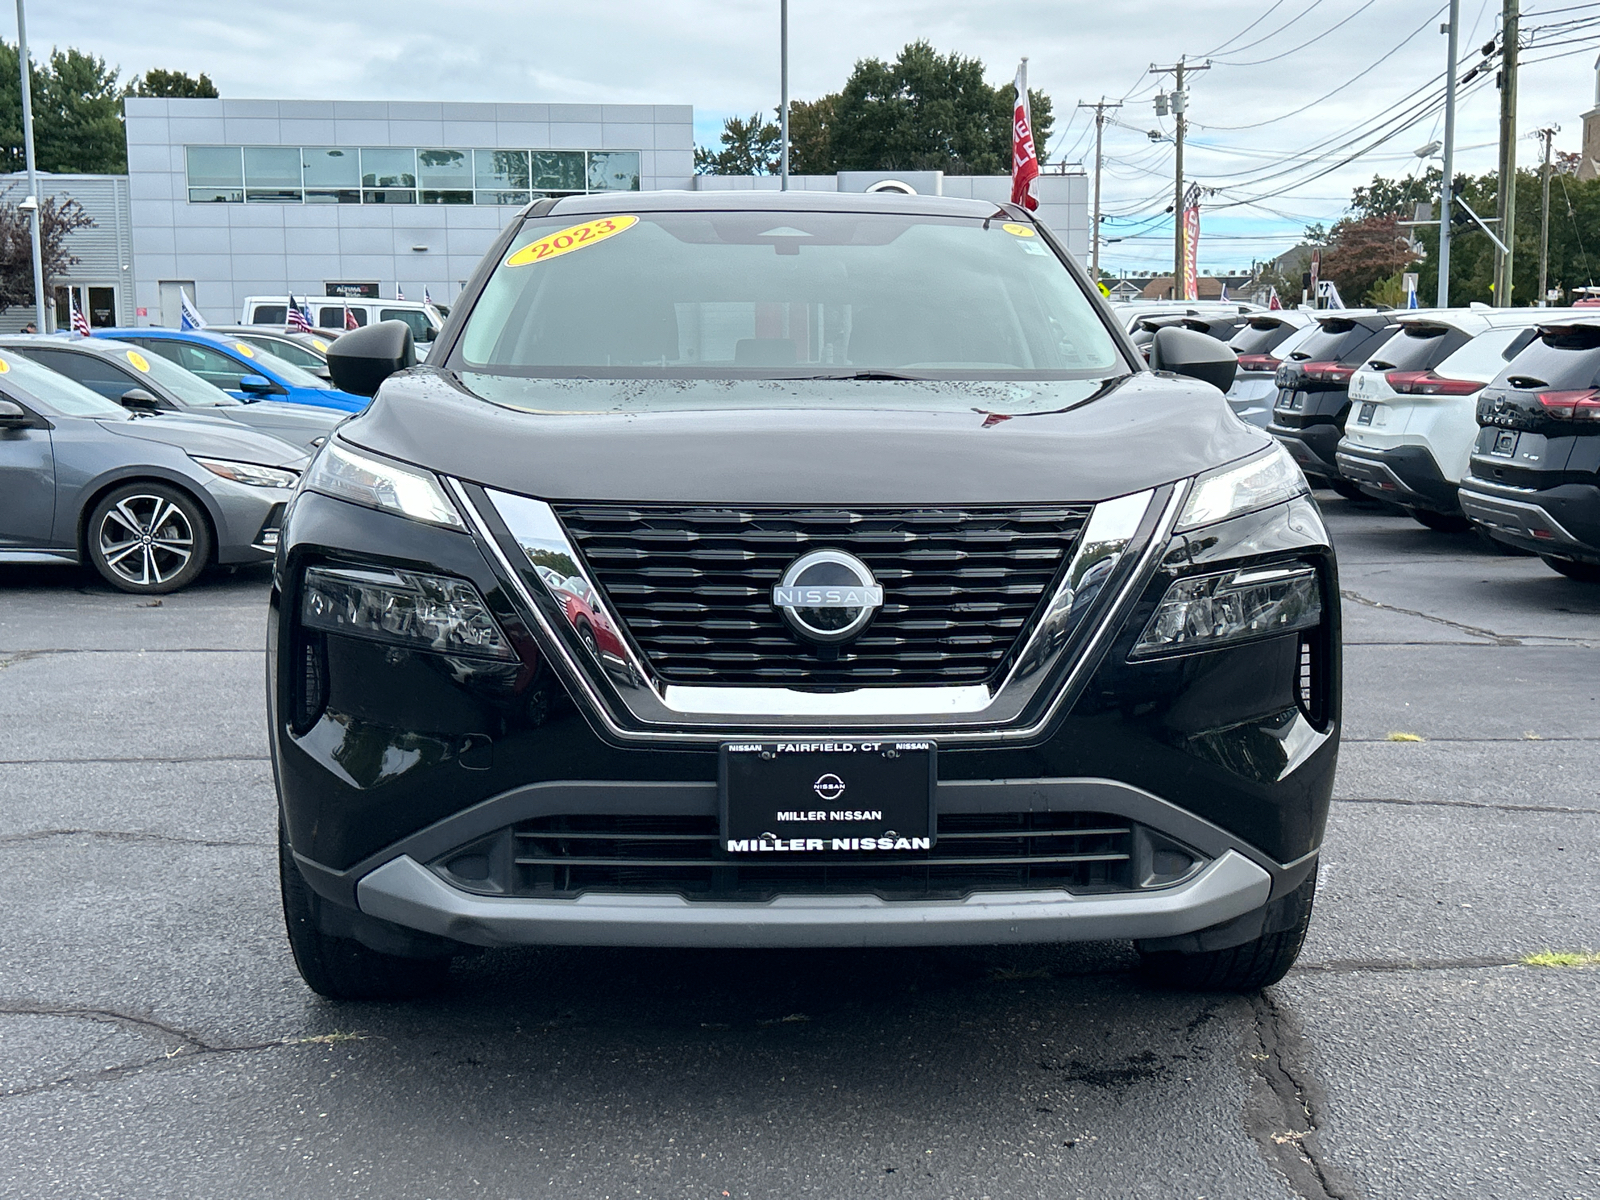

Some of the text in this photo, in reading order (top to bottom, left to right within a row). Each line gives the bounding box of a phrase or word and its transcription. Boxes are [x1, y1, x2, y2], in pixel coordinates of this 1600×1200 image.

[531, 220, 617, 259] 2023
[336, 285, 362, 293] ALTIMA
[777, 590, 879, 603] NISSAN
[729, 744, 762, 752] NISSAN
[776, 742, 882, 753] FAIRFIELD, CT
[777, 810, 882, 821] MILLER NISSAN
[727, 837, 930, 852] MILLER NISSAN
